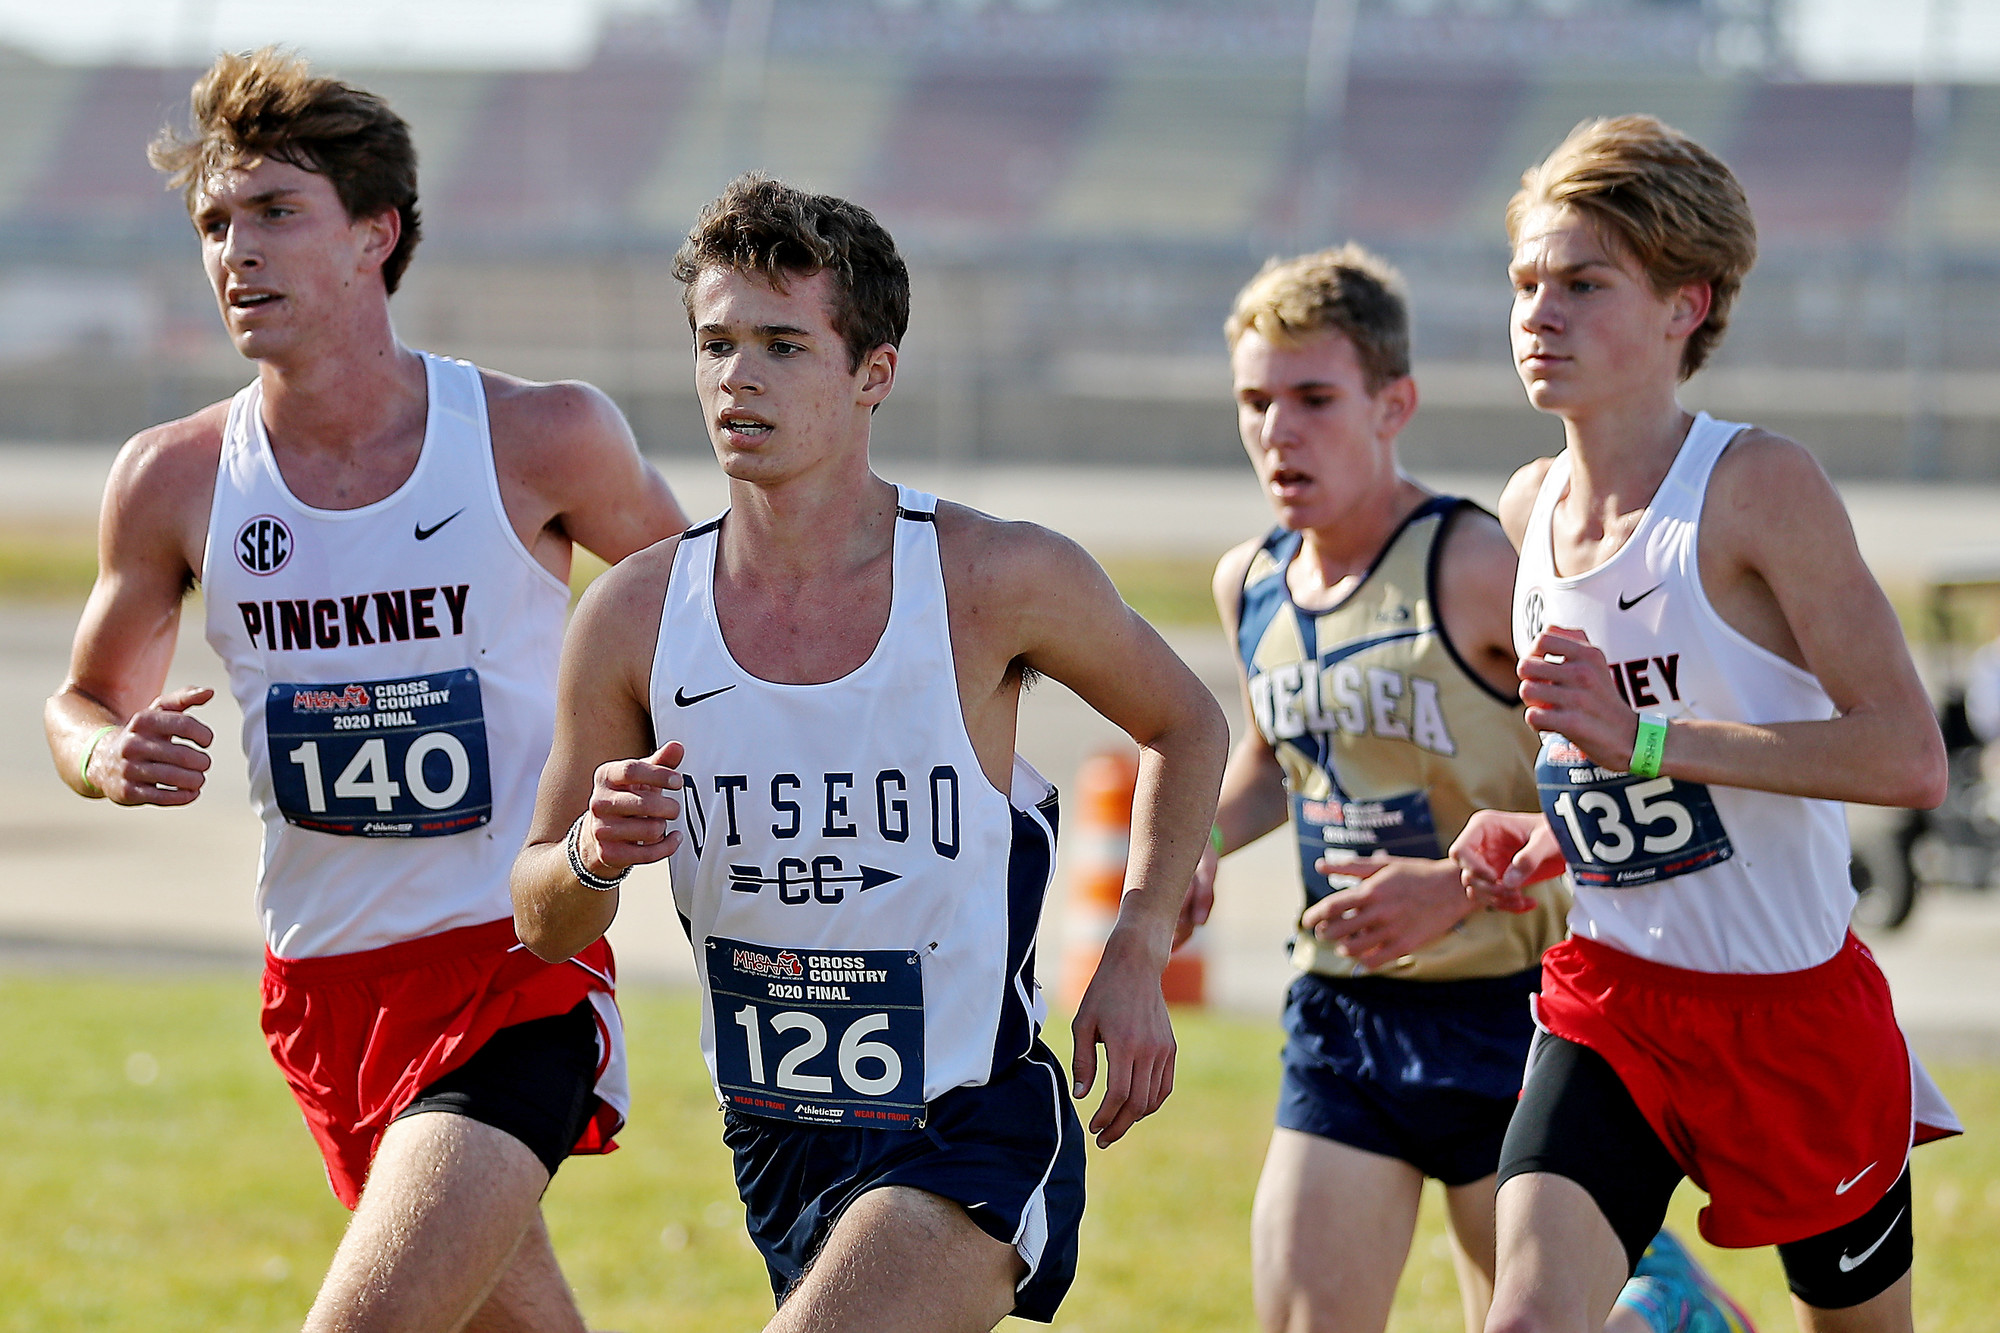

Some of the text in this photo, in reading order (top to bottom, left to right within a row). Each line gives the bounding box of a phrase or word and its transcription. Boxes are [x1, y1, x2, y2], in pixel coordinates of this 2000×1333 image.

[240, 519, 288, 571] SEC
[238, 584, 470, 651] PINCKNEY
[374, 680, 430, 698] CROSS
[376, 689, 451, 711] COUNTRY
[333, 711, 417, 731] 2020 FINAL
[289, 731, 471, 813] 140
[682, 764, 960, 862] OTSEGO
[1553, 775, 1694, 864] 135
[777, 855, 845, 905] CC
[733, 949, 795, 976] MHSAA
[808, 956, 866, 970] CROSS
[809, 969, 888, 984] COUNTRY
[768, 983, 851, 1001] 2020 FINAL
[734, 1004, 903, 1097] 126
[854, 1110, 875, 1119] WEAR
[876, 1111, 886, 1120] ON
[887, 1112, 911, 1122] FRONT
